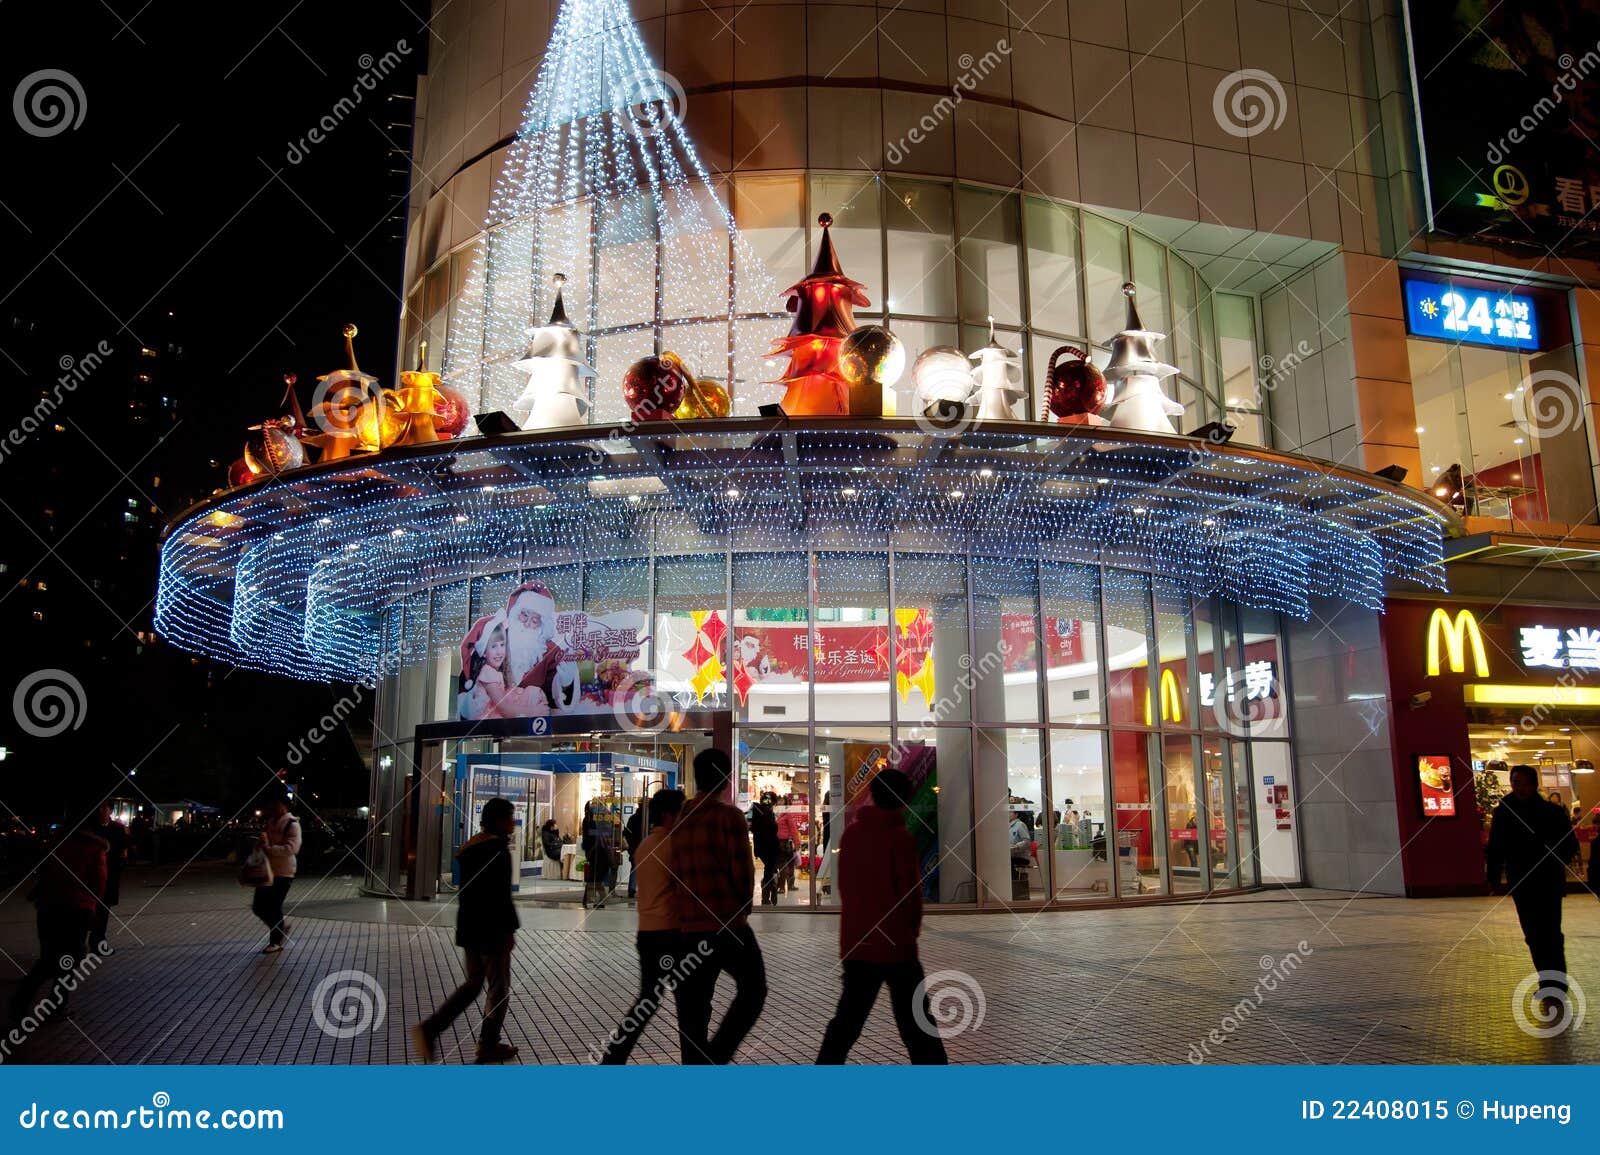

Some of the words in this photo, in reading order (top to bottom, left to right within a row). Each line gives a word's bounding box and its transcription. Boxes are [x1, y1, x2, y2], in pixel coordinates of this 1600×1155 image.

[1441, 292, 1493, 335] 24
[556, 613, 588, 634] 相伴
[572, 629, 637, 650] 快乐圣诞
